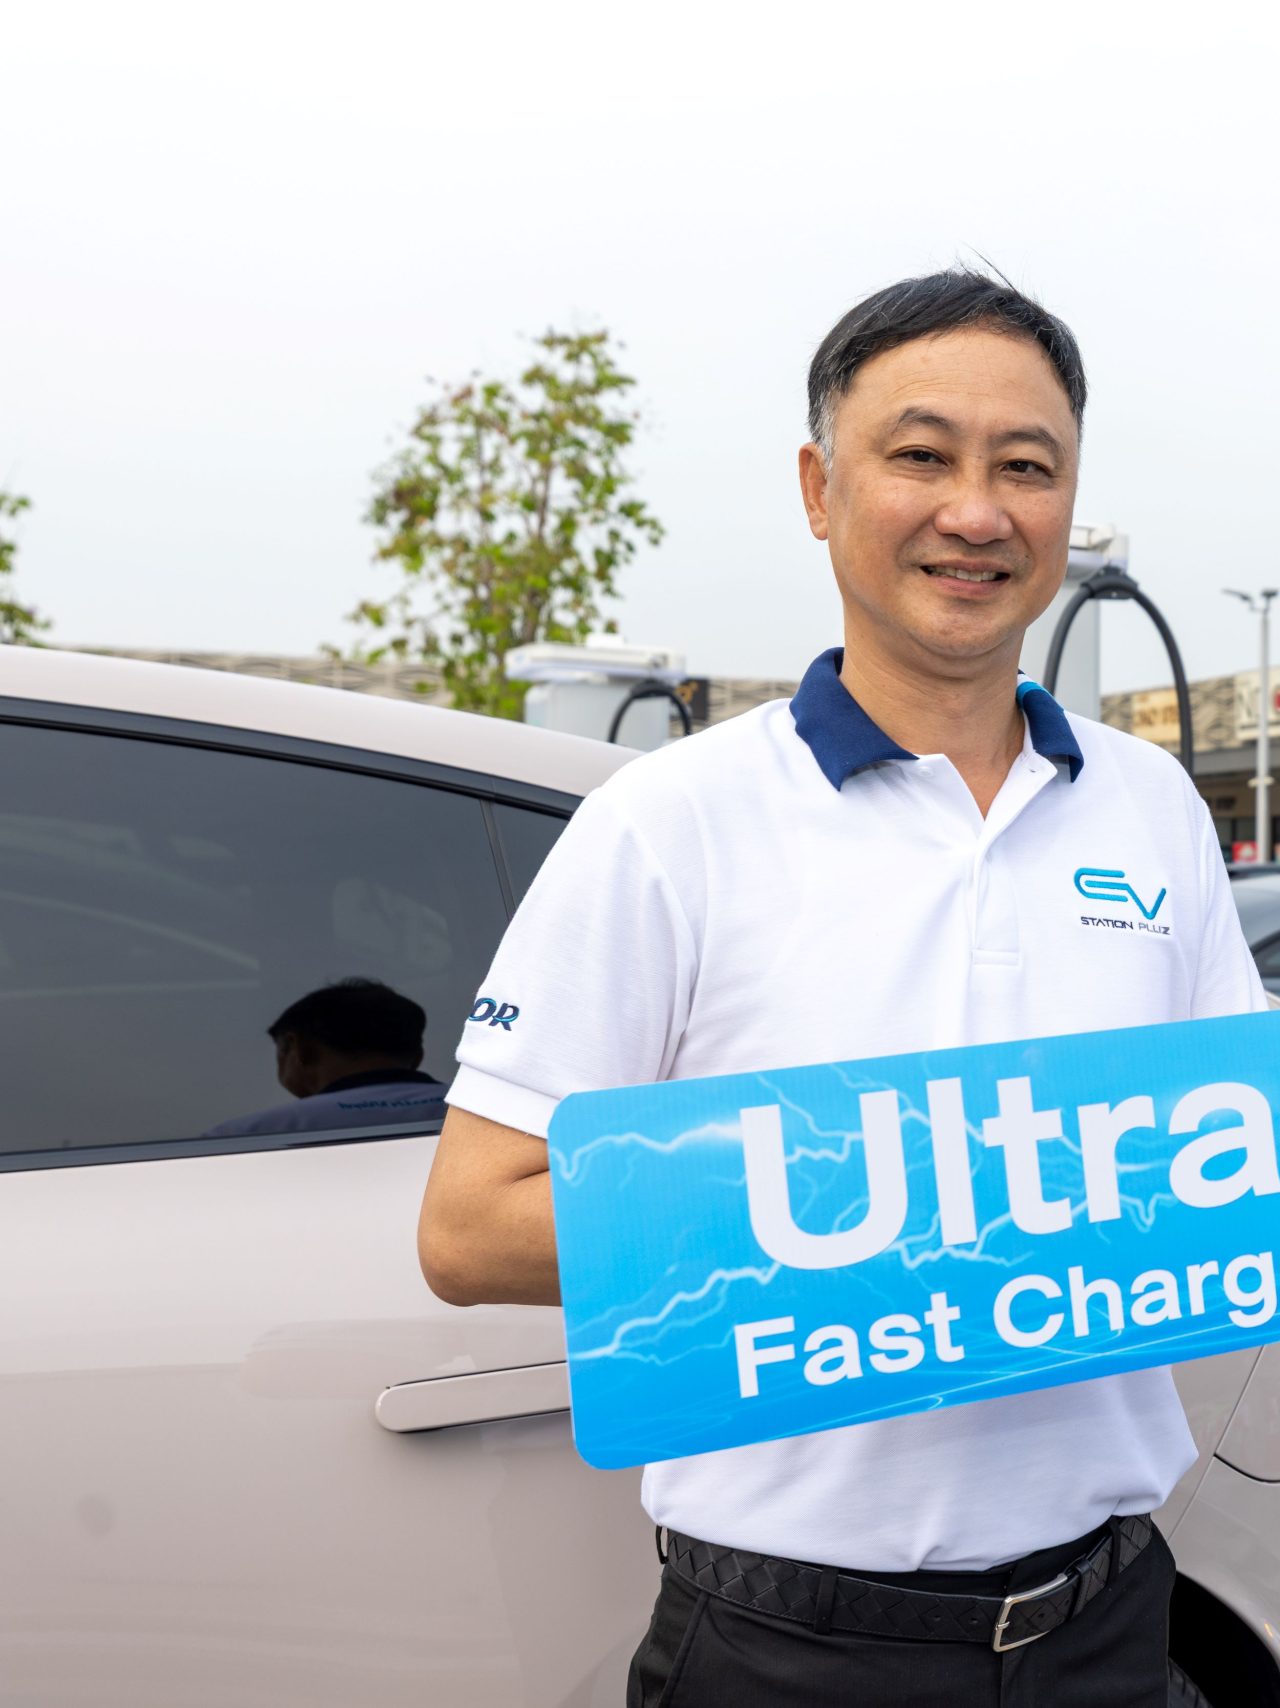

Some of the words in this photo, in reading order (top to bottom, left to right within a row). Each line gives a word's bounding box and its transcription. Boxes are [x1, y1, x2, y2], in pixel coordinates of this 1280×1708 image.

[1074, 867, 1167, 920] EV
[1080, 916, 1134, 930] STATION
[468, 997, 520, 1031] OR
[733, 1291, 965, 1399] Fast
